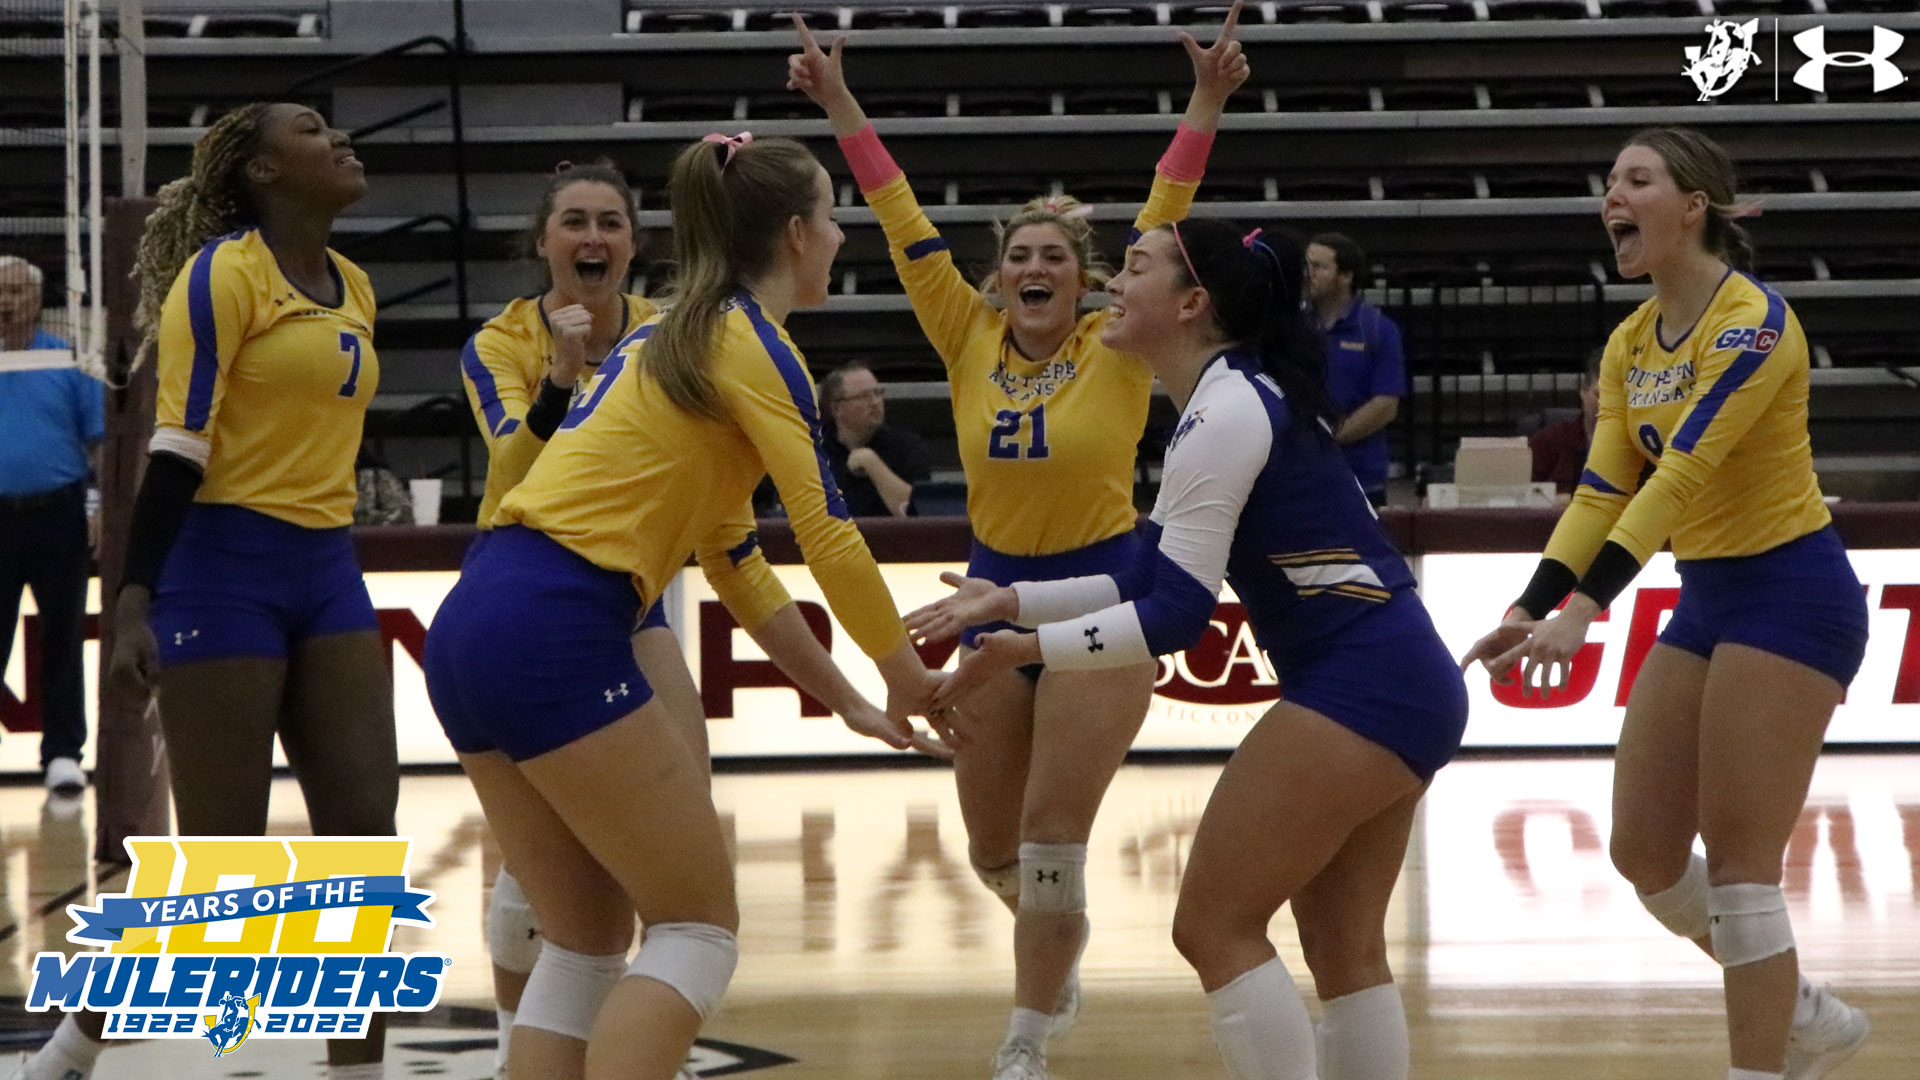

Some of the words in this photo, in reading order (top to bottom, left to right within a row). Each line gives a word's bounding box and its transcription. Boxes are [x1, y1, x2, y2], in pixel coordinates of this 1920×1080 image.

[337, 331, 361, 398] 7
[1715, 327, 1778, 352] GAC
[987, 402, 1050, 460] 21
